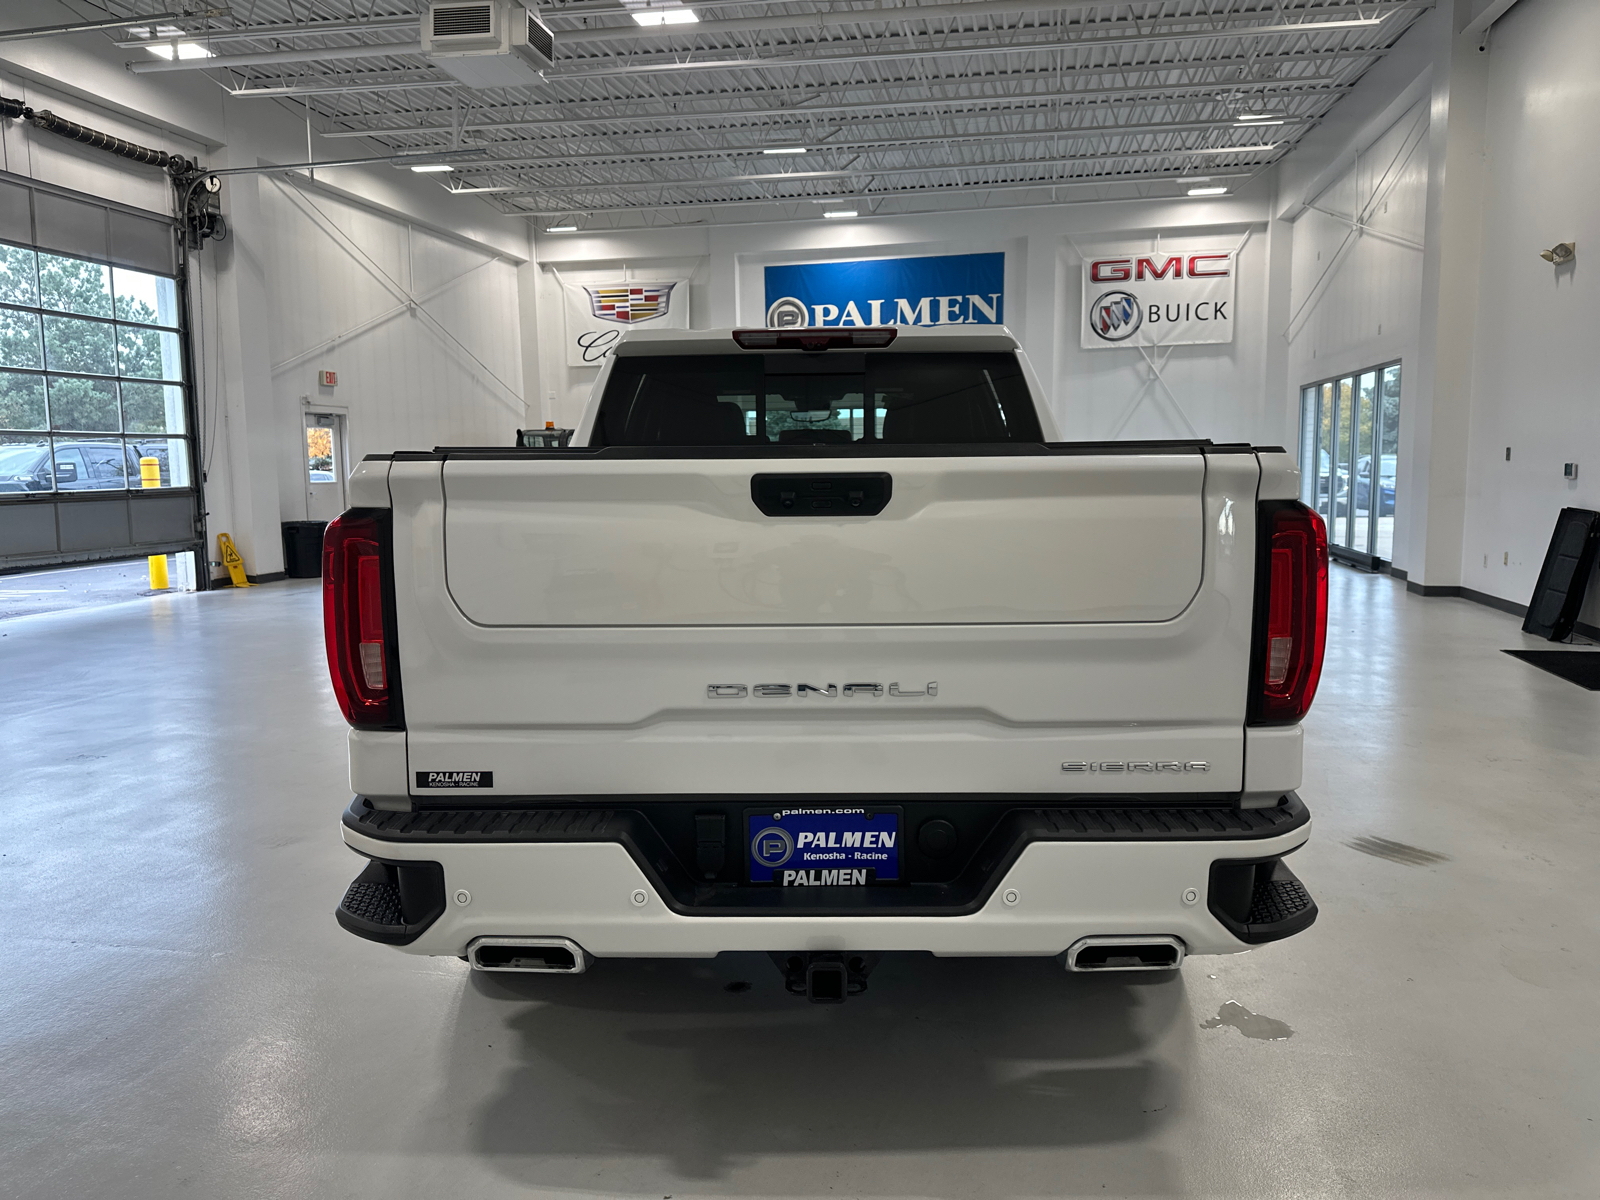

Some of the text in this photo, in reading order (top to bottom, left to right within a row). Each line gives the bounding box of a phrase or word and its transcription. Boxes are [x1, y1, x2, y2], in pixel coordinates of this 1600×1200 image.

[1090, 253, 1230, 284] GMC
[811, 293, 1002, 327] PALMEN
[1148, 301, 1228, 323] BUICK
[707, 681, 938, 699] DENALI
[1061, 761, 1211, 772] SIERRA
[428, 772, 480, 782] PALMEN
[782, 808, 865, 816] palmen.com
[796, 832, 896, 848] PALMEN
[803, 852, 846, 860] Kenosha
[854, 852, 888, 860] Racine
[783, 869, 867, 886] PALMEN
